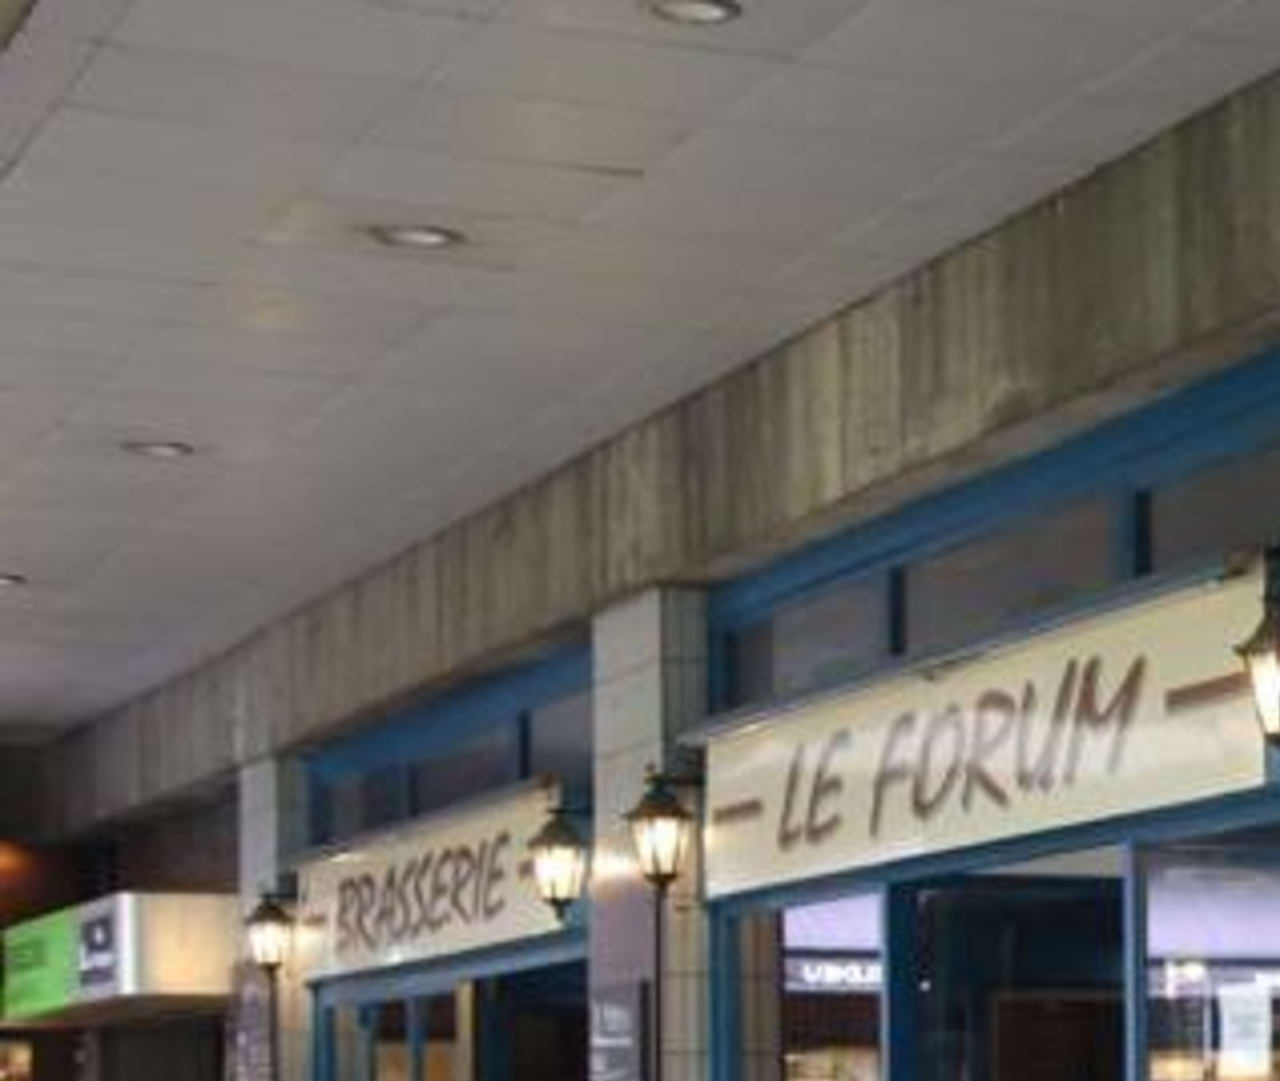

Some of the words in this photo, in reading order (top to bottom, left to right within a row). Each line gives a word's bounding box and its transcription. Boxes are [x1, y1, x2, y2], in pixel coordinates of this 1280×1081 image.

[777, 726, 849, 853] LE
[869, 652, 1148, 839] FORUM
[335, 829, 511, 956] BRASSERIE
